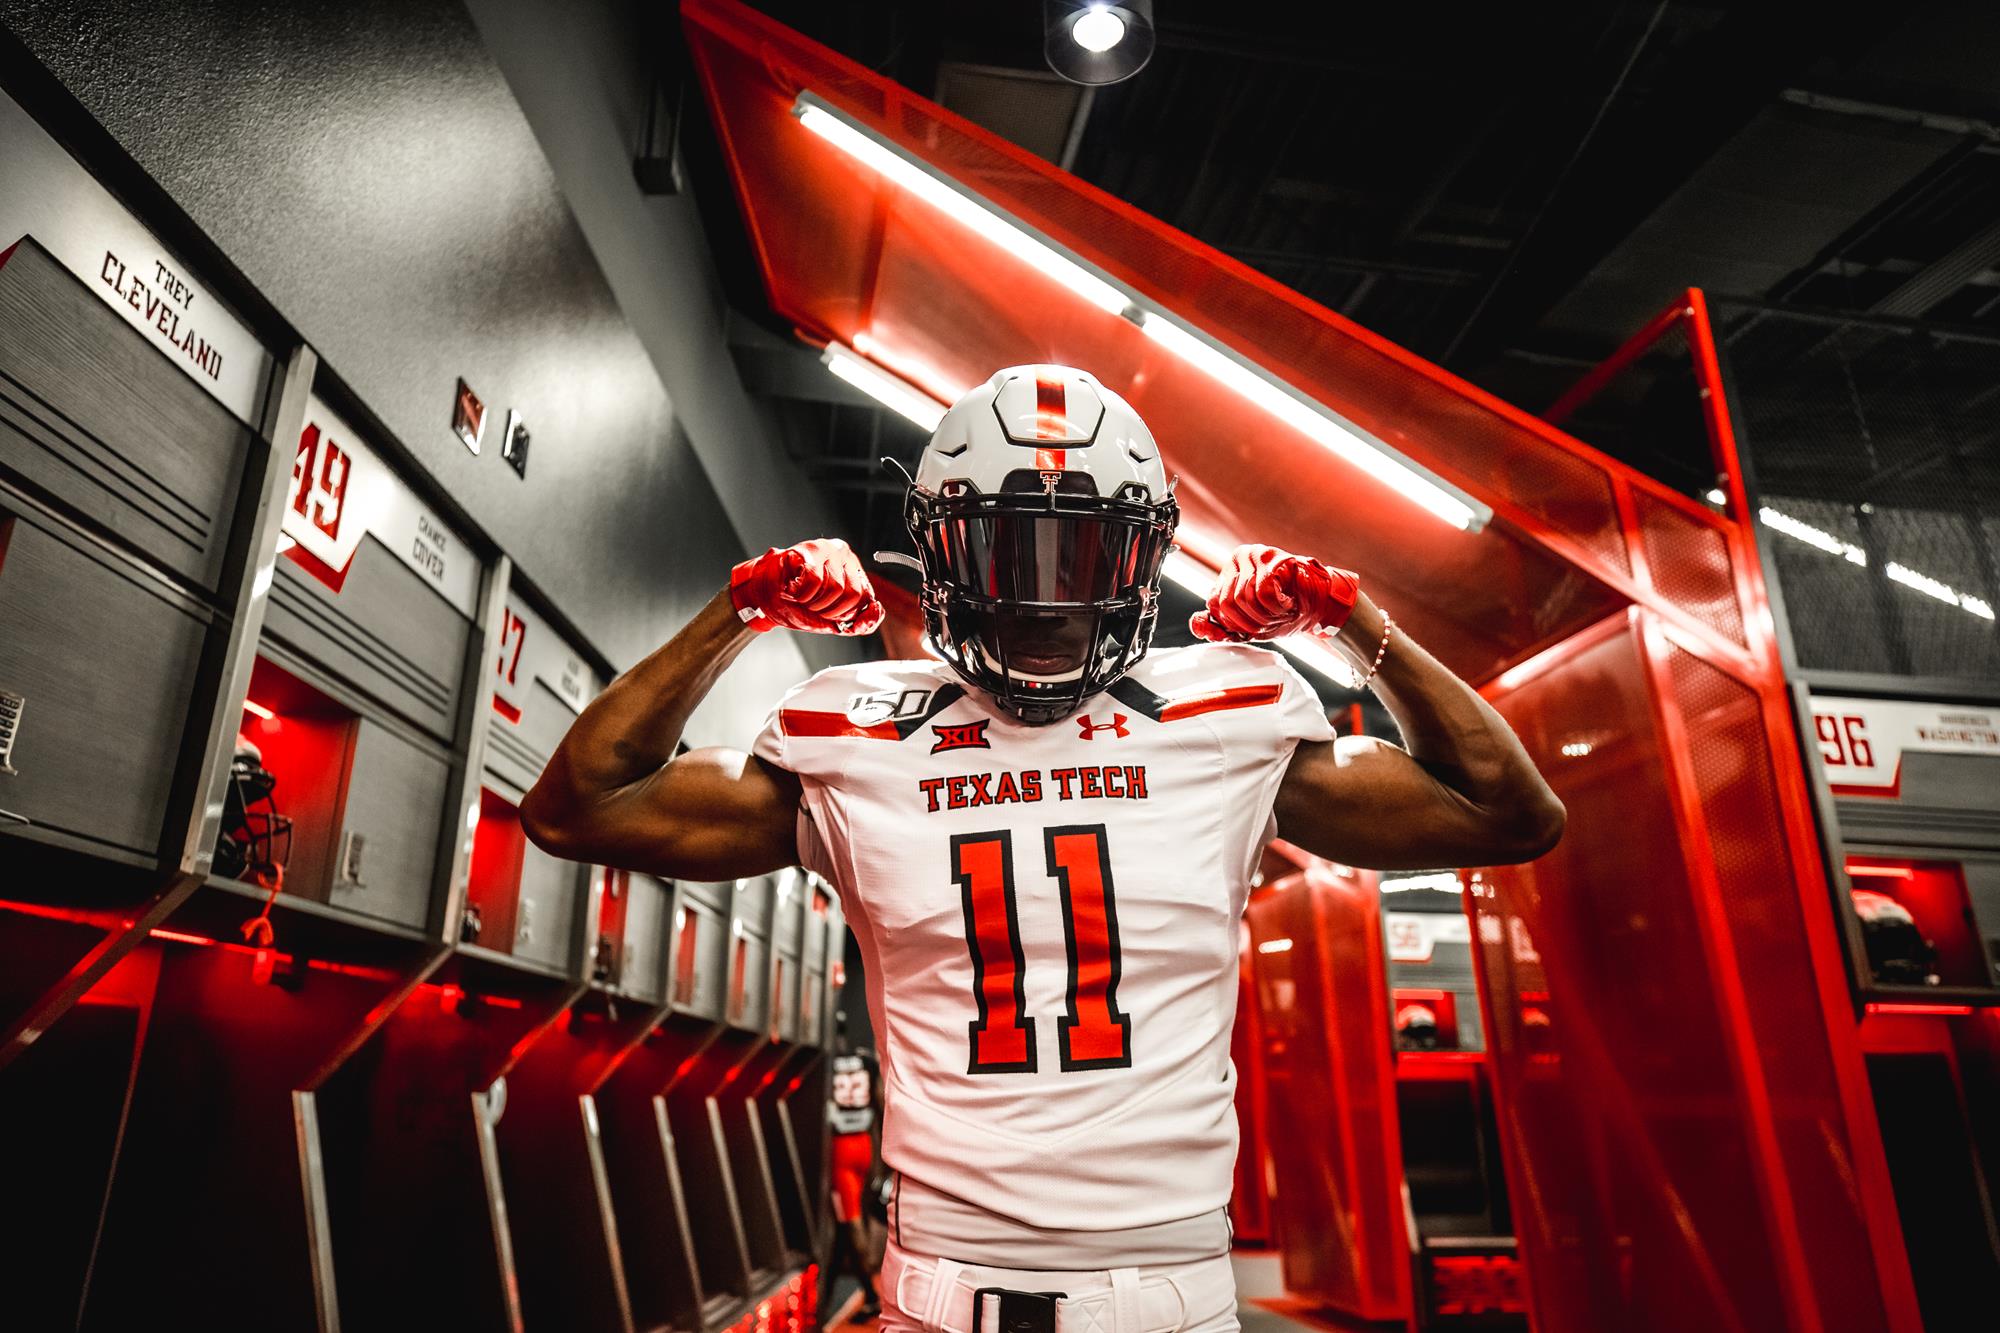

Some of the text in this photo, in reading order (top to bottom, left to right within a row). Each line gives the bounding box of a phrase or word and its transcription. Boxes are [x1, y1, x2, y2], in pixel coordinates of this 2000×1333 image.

[155, 260, 195, 310] TREY
[101, 250, 223, 381] CLEVELAND
[931, 720, 990, 753] XII
[1814, 715, 1876, 769] 96
[919, 766, 1149, 812] TEXAS TECH
[950, 823, 1132, 1075] 11
